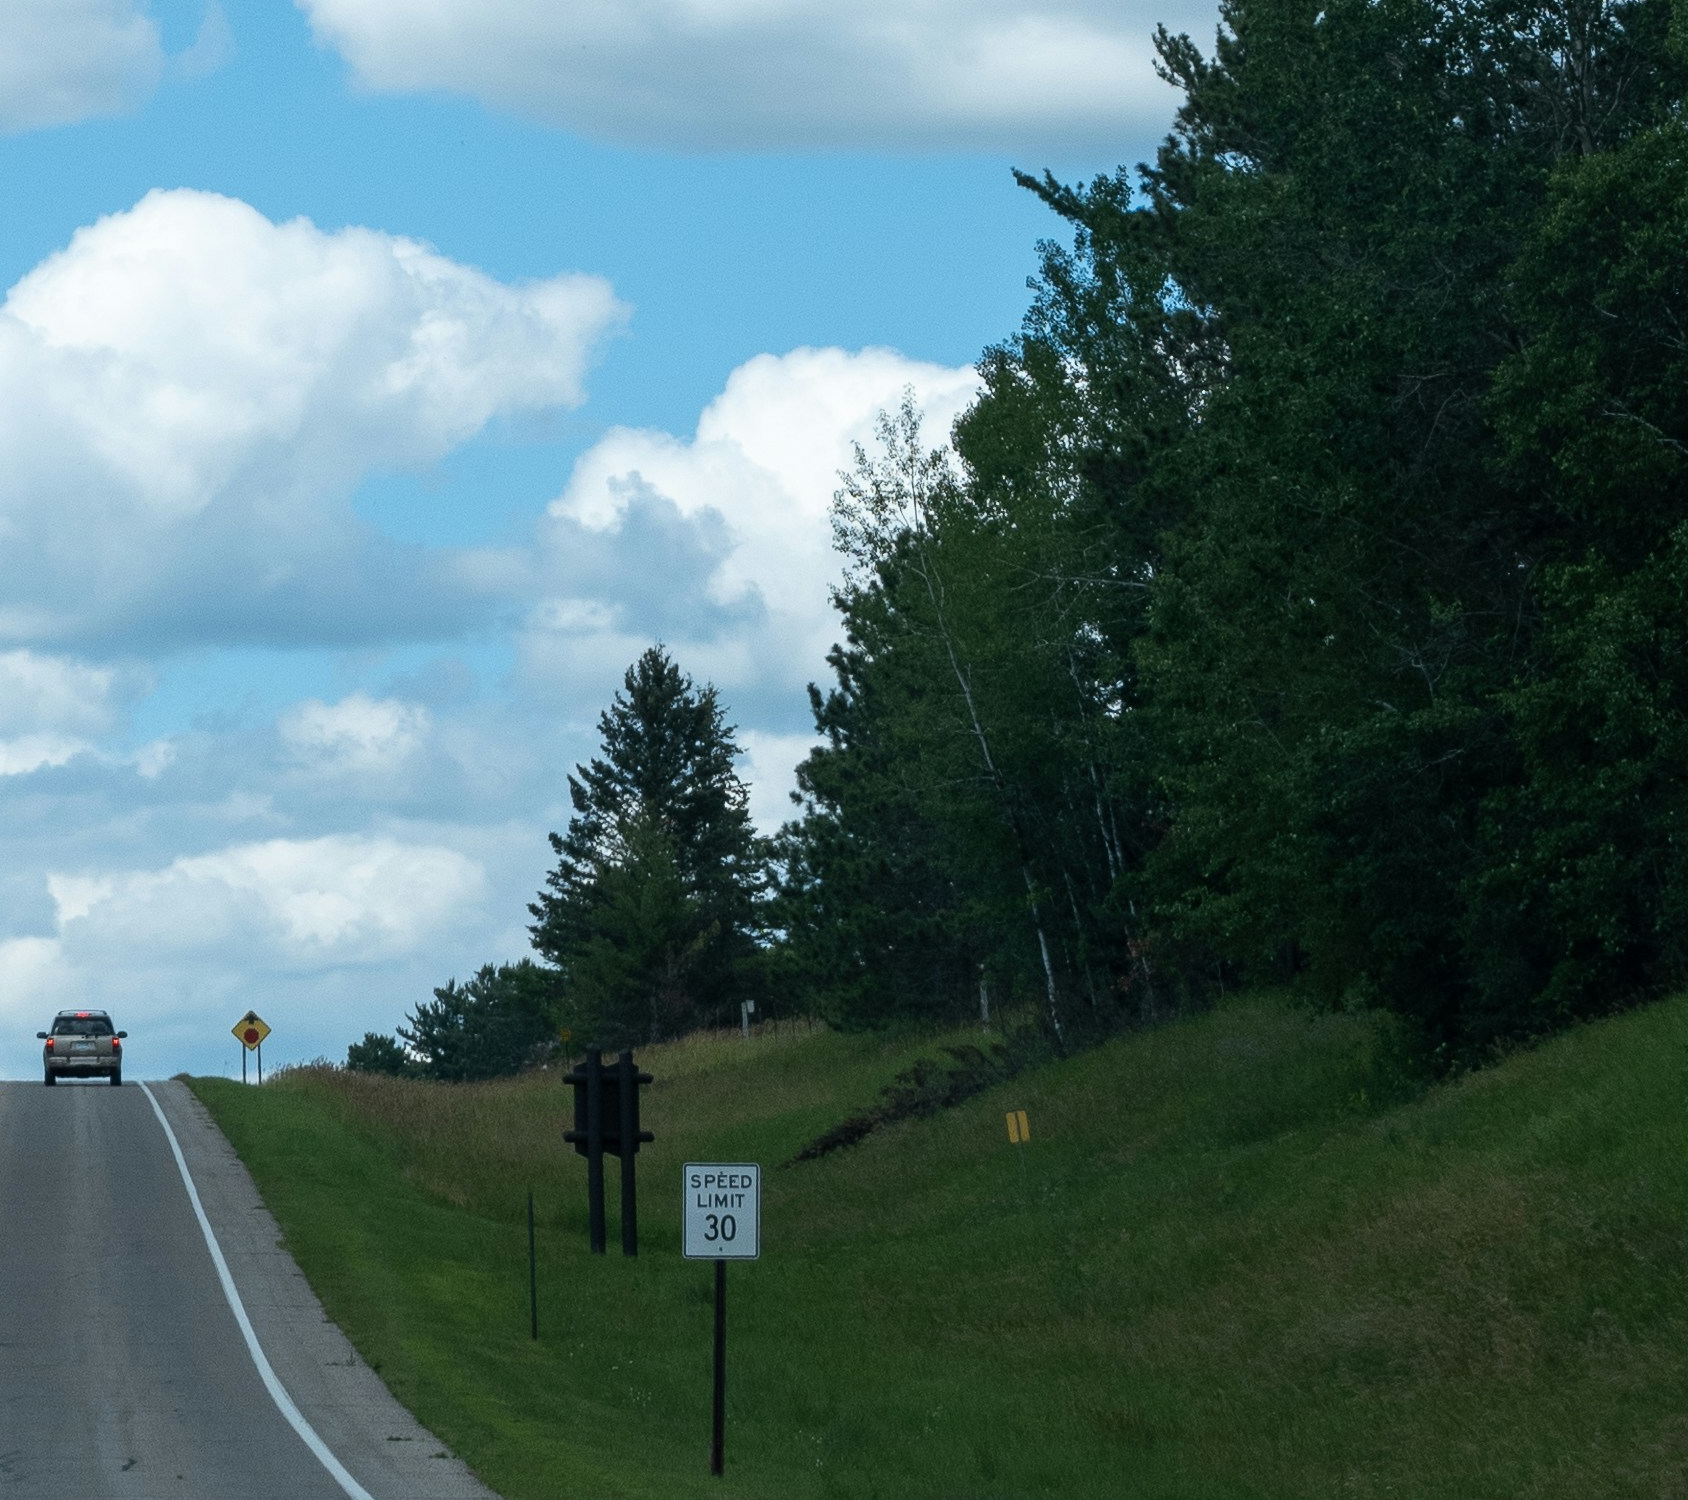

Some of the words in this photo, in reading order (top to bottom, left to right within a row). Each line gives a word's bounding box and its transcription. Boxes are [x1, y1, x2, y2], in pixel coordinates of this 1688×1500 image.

[691, 1174, 752, 1189] SPEED
[697, 1193, 745, 1208] LIMIT
[704, 1214, 737, 1241] 30
